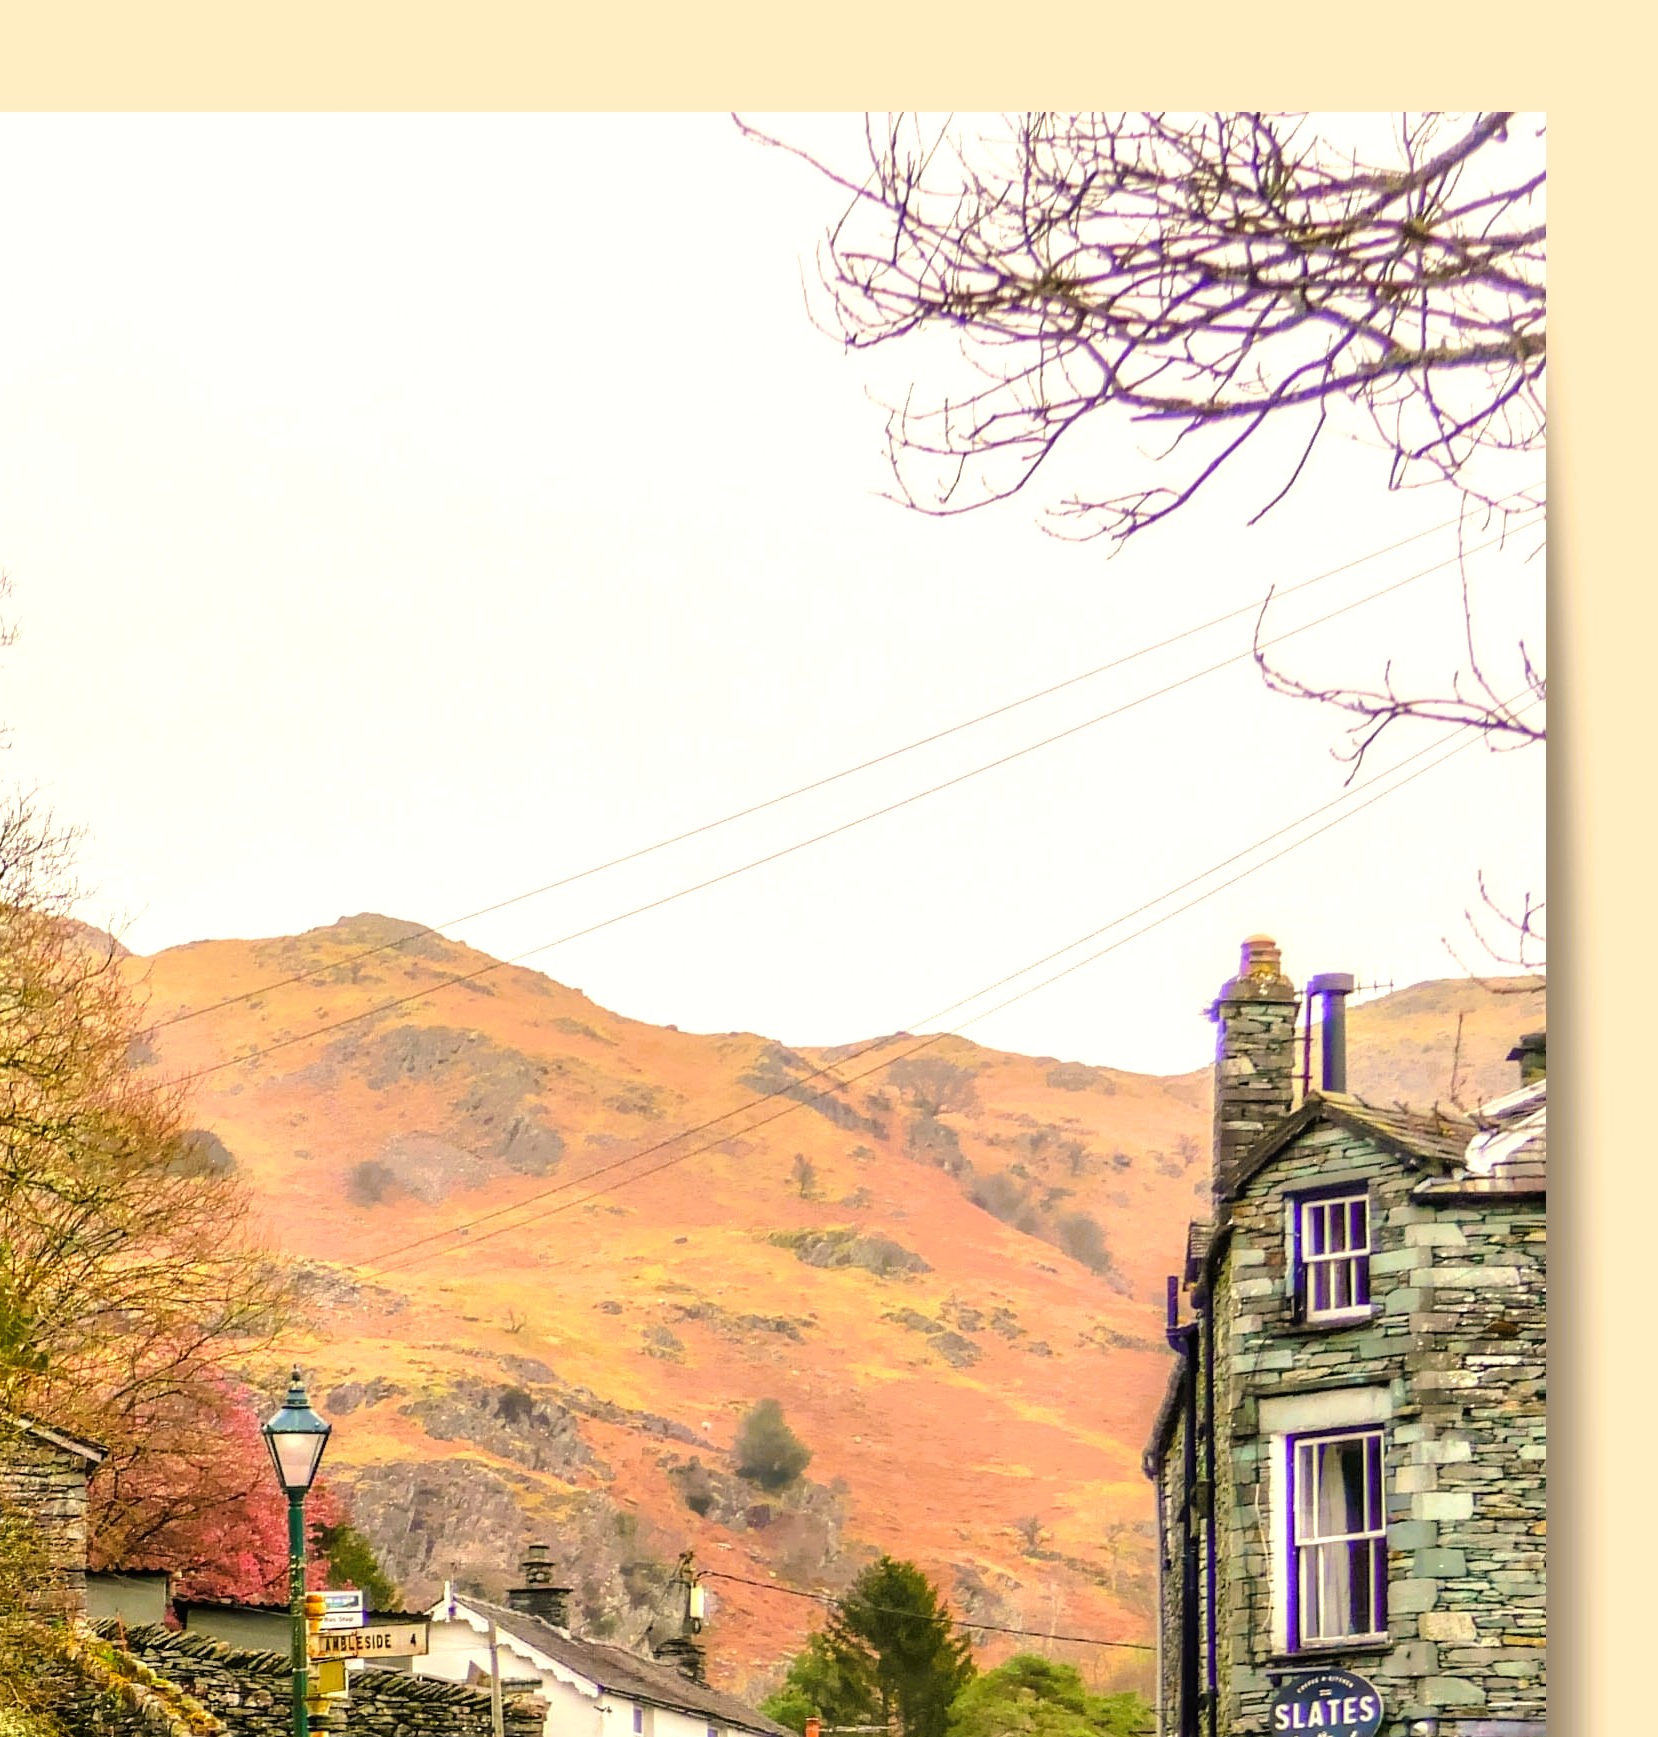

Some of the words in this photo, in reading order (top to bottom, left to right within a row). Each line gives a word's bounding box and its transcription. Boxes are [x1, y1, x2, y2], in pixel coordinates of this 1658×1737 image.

[325, 1634, 392, 1652] AMBLESIDE
[410, 1633, 417, 1647] 4
[1274, 1695, 1375, 1731] SLATES
